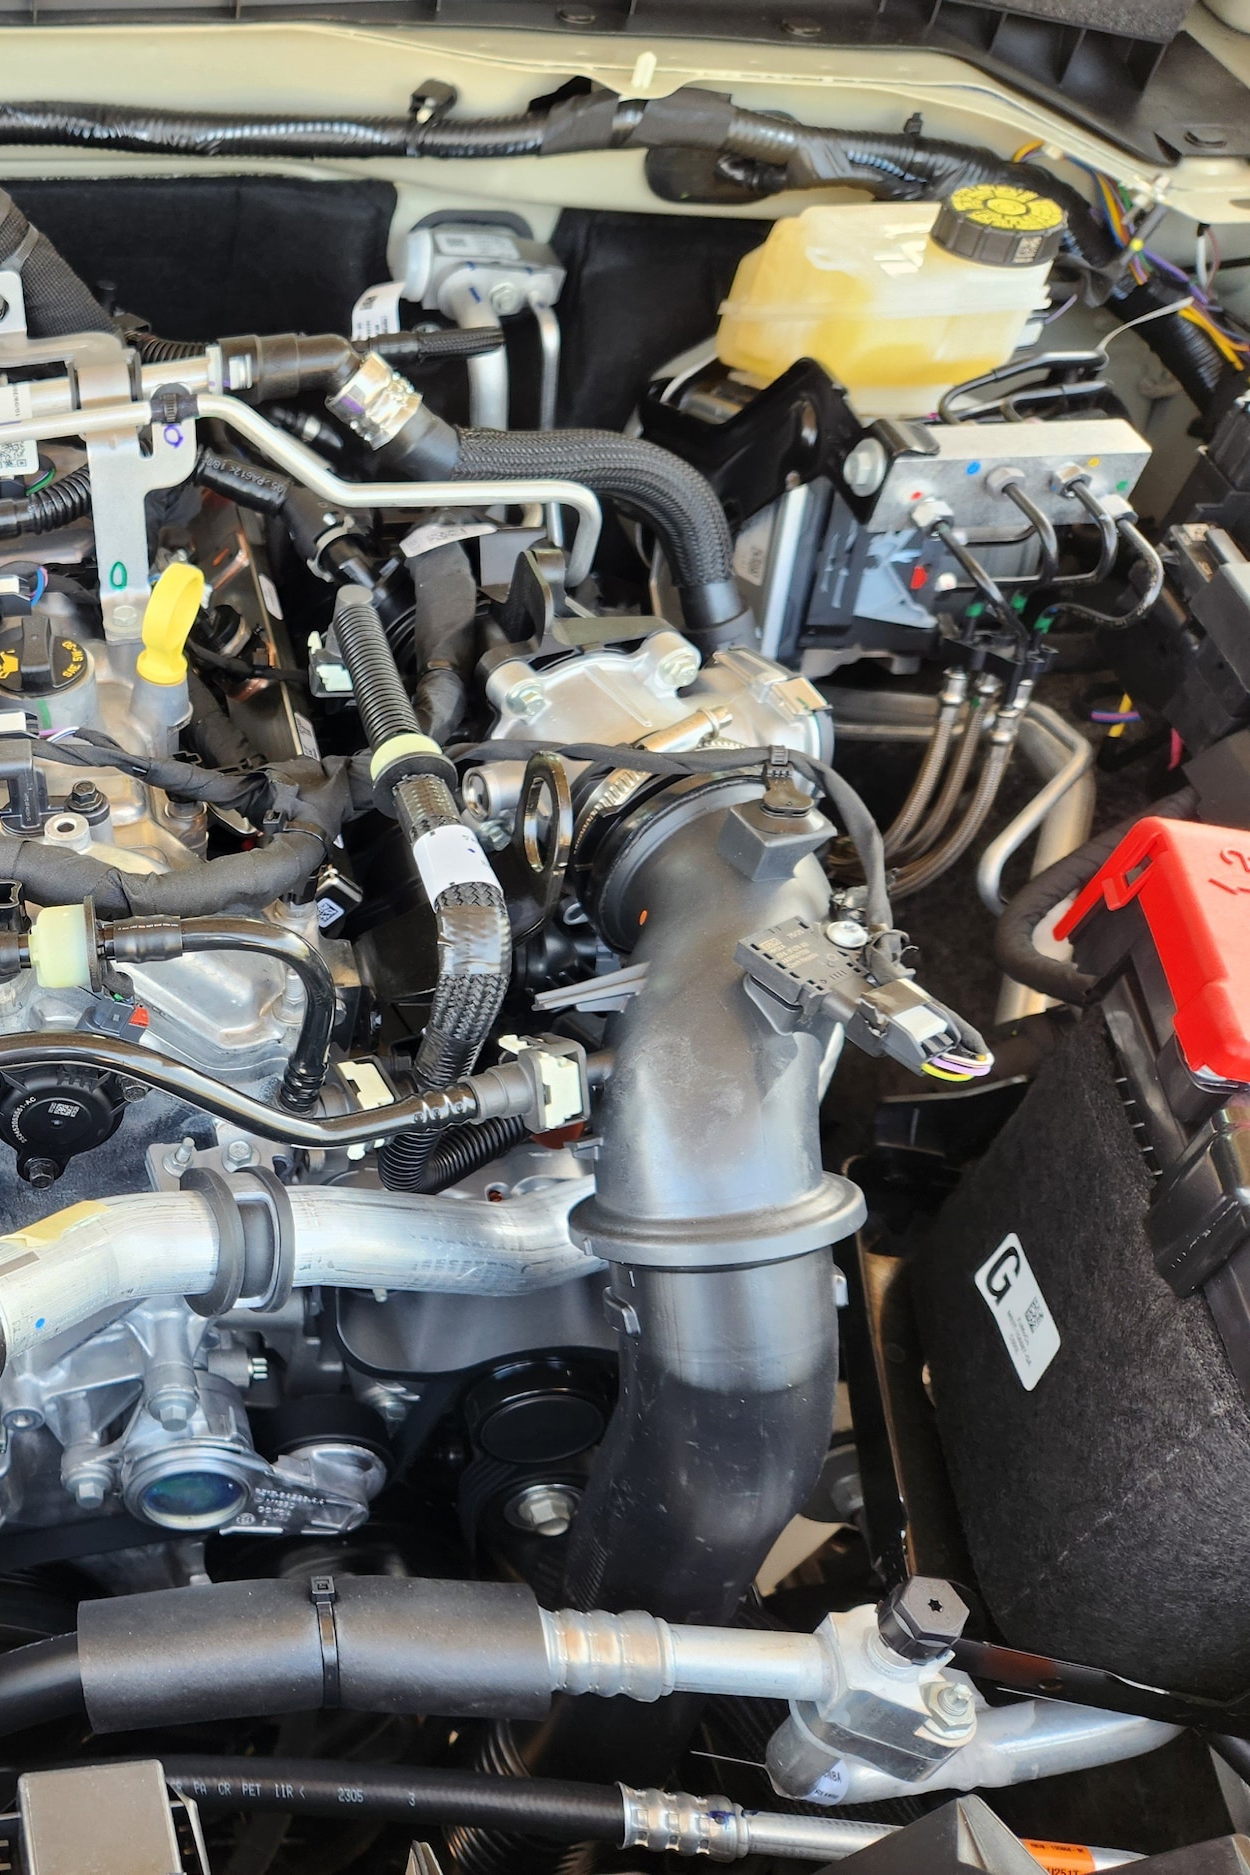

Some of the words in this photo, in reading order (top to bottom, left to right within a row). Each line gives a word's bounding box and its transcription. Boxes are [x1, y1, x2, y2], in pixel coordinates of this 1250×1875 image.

[62, 663, 82, 678] SAE
[194, 1783, 207, 1795] PA
[242, 1783, 262, 1797] PET
[337, 1787, 364, 1803] 2305
